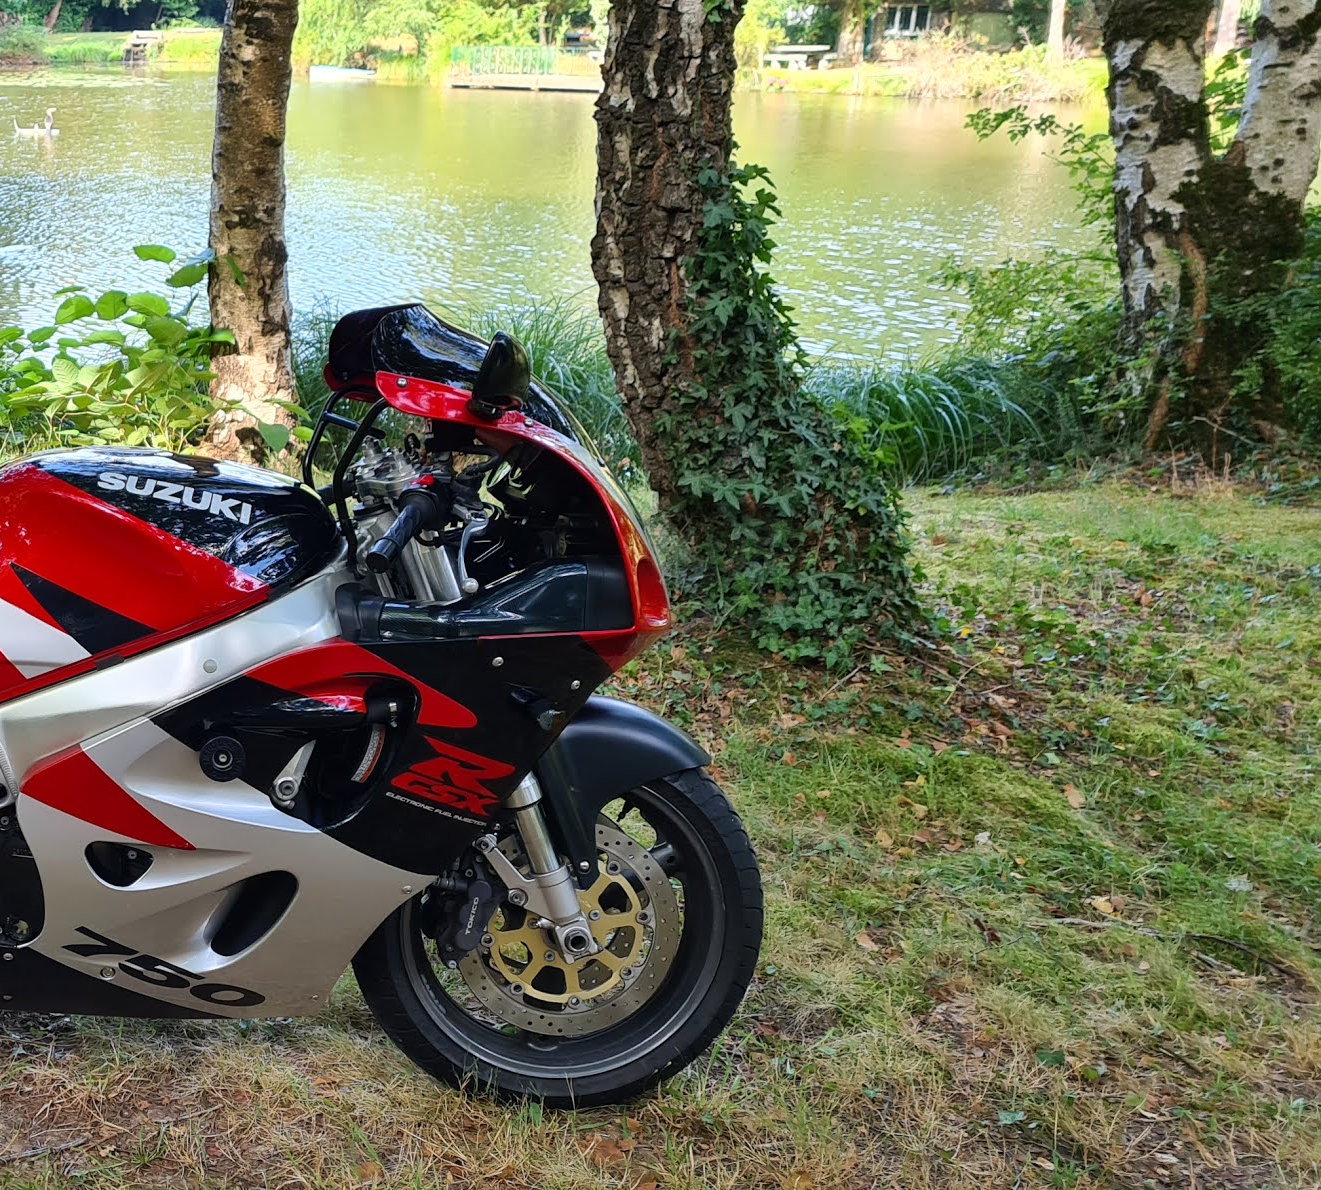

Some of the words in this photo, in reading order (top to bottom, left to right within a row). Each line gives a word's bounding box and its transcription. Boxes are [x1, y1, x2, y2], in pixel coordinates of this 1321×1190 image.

[97, 471, 252, 525] SUZUKI
[385, 791, 435, 812] ELECTRONIC
[434, 808, 453, 818] FUEL
[465, 897, 479, 935] TOKICO
[61, 925, 266, 1006] 750
